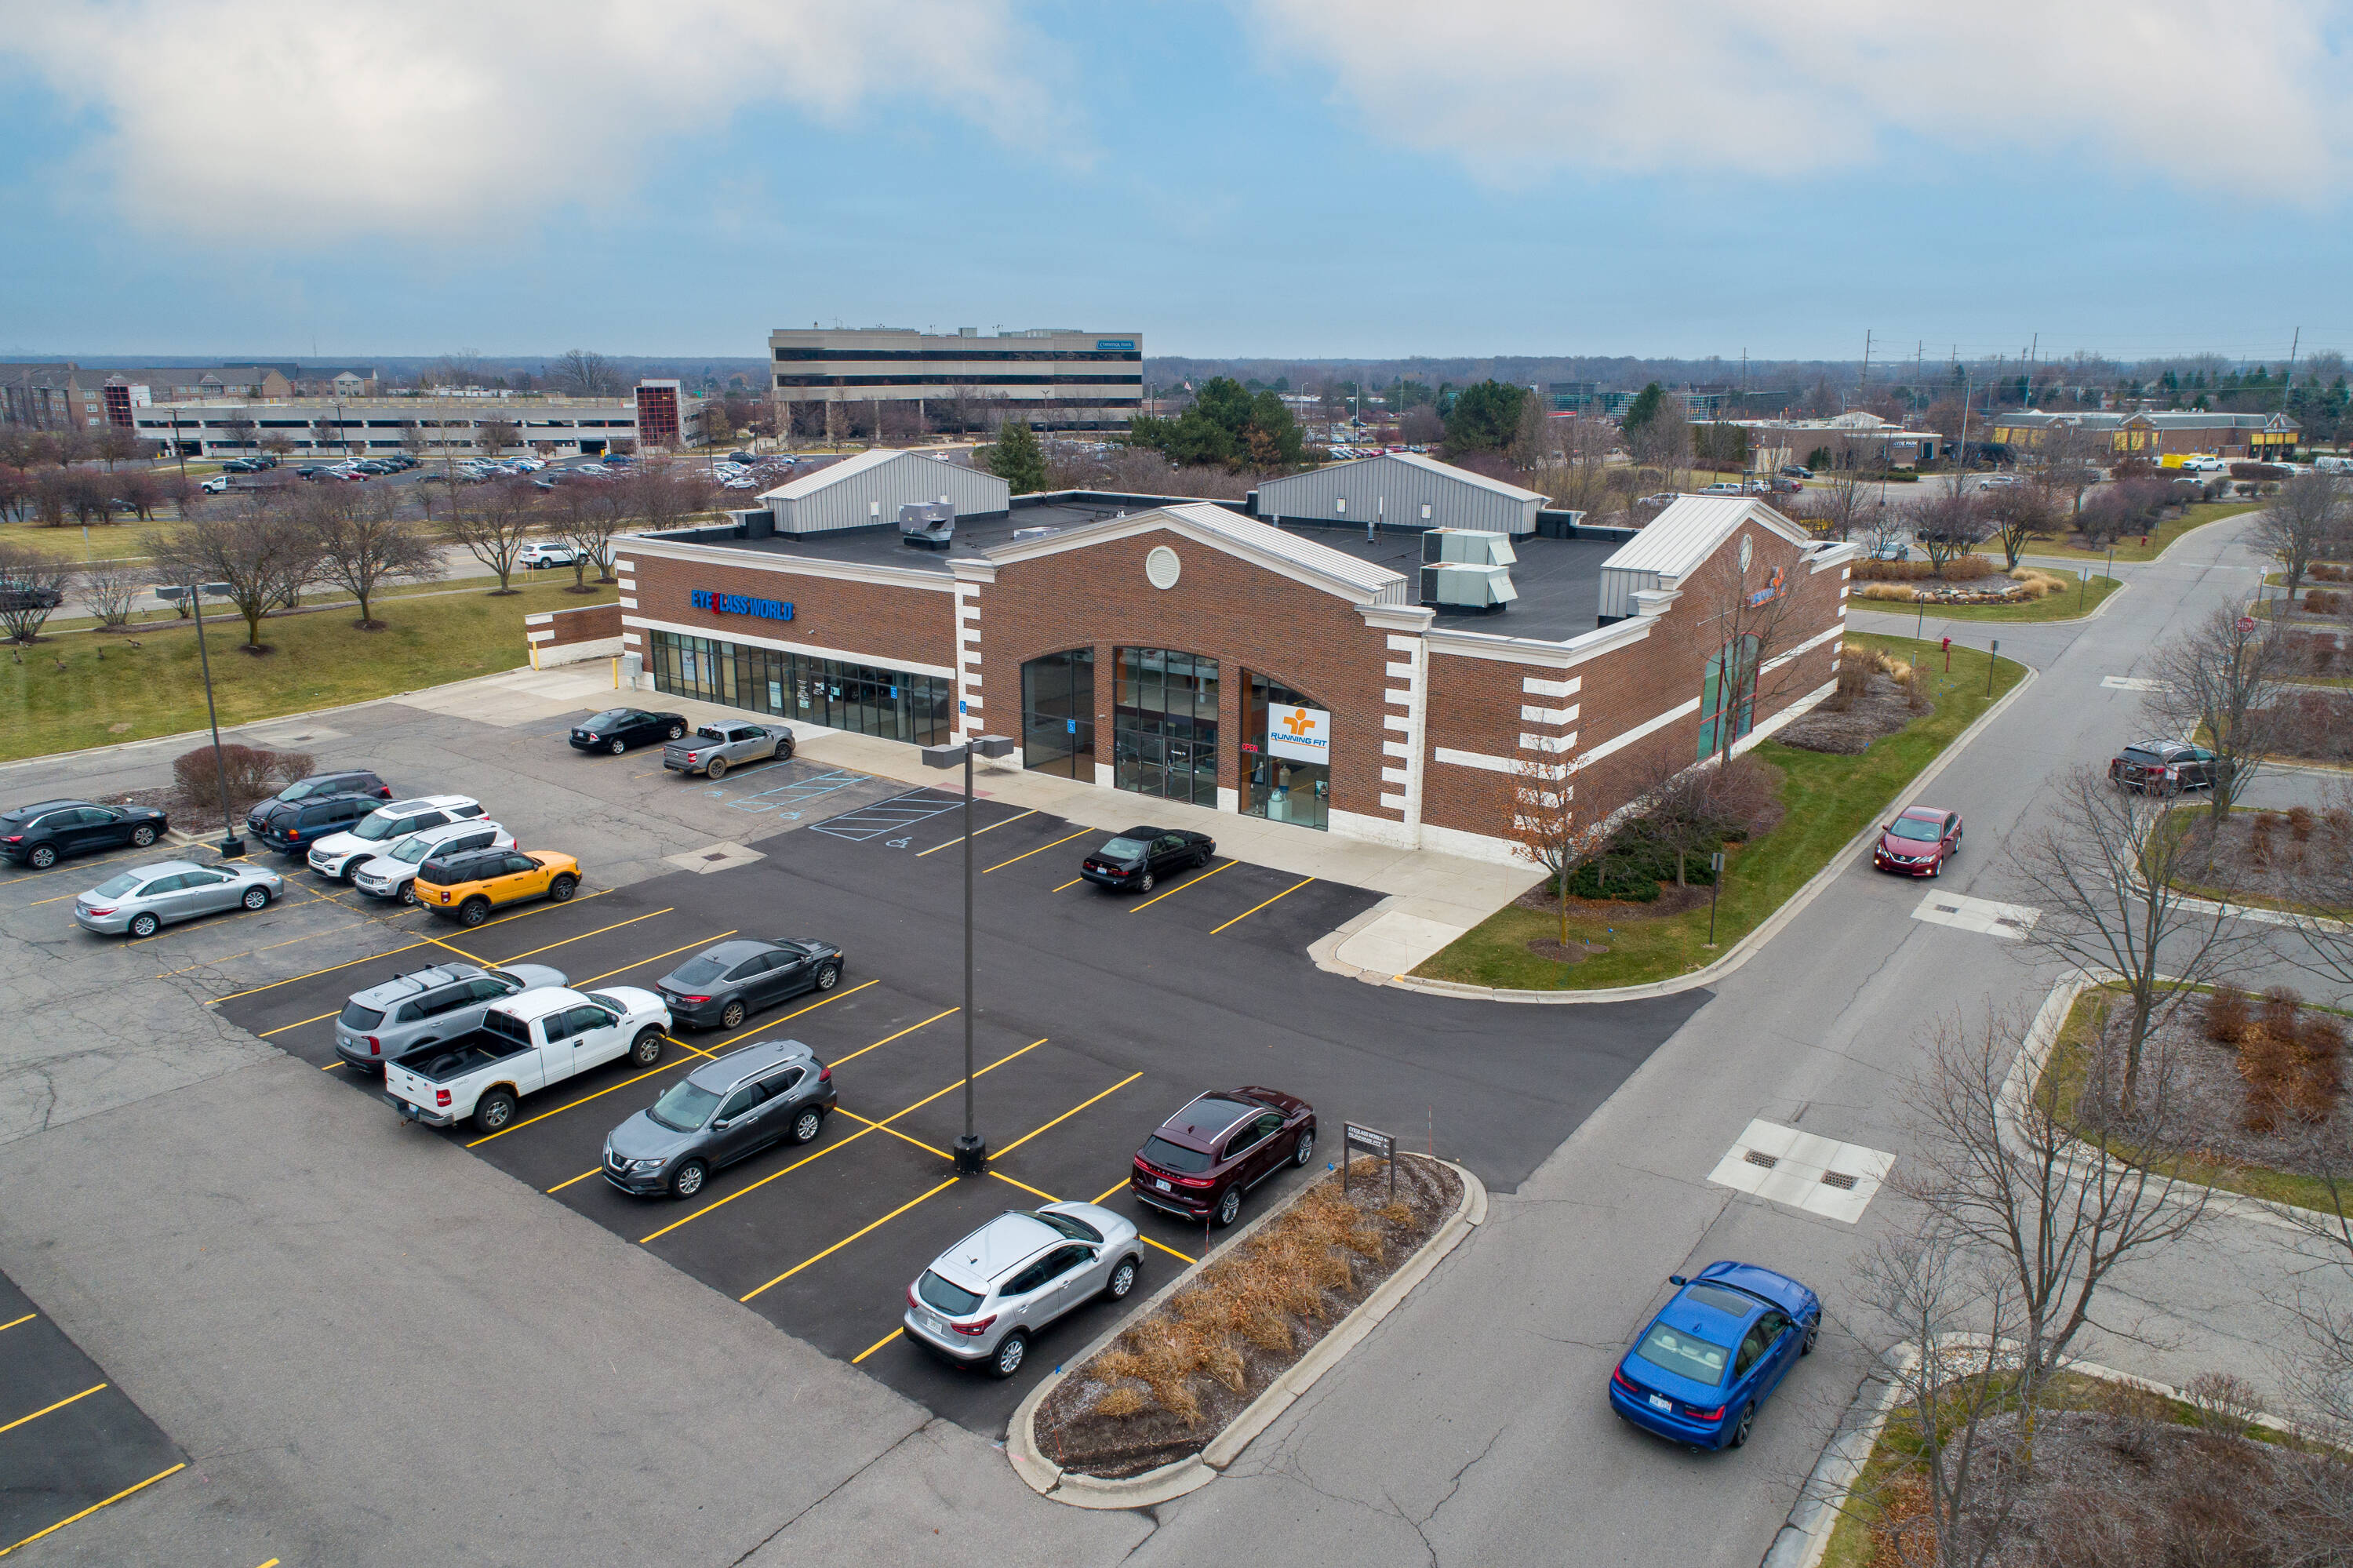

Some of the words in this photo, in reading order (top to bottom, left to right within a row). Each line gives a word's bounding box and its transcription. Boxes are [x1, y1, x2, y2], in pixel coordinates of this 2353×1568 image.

[748, 598, 795, 621] WORLD
[1271, 732, 1311, 745] RUNNING
[1242, 743, 1258, 752] OPEN
[1369, 1132, 1384, 1141] WORLD
